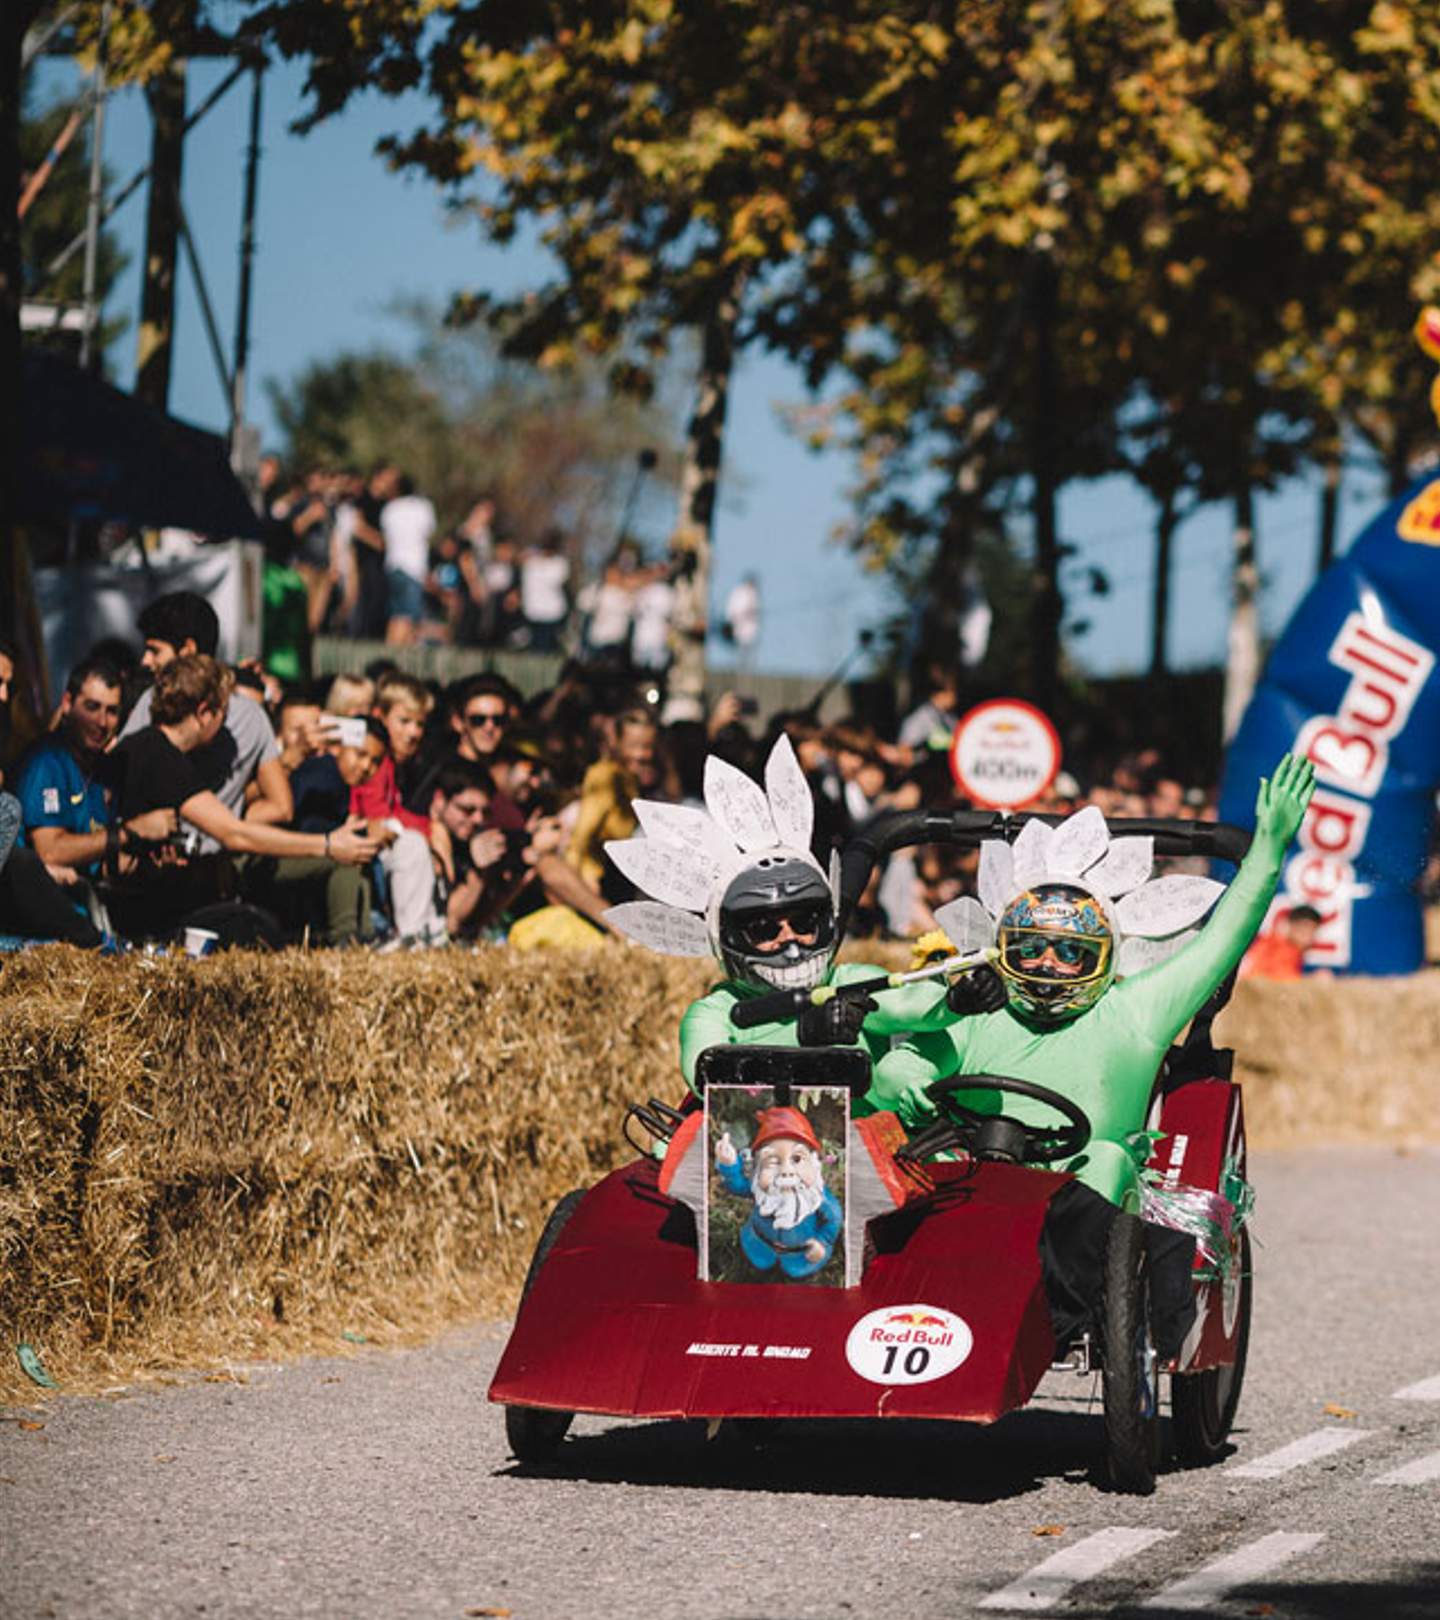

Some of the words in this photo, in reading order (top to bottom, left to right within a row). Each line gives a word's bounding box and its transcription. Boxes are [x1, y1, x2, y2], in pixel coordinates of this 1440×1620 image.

[1306, 627, 1420, 778] Bull
[870, 1328, 911, 1342] Red
[912, 1330, 954, 1346] Bull
[882, 1346, 930, 1376] 10
